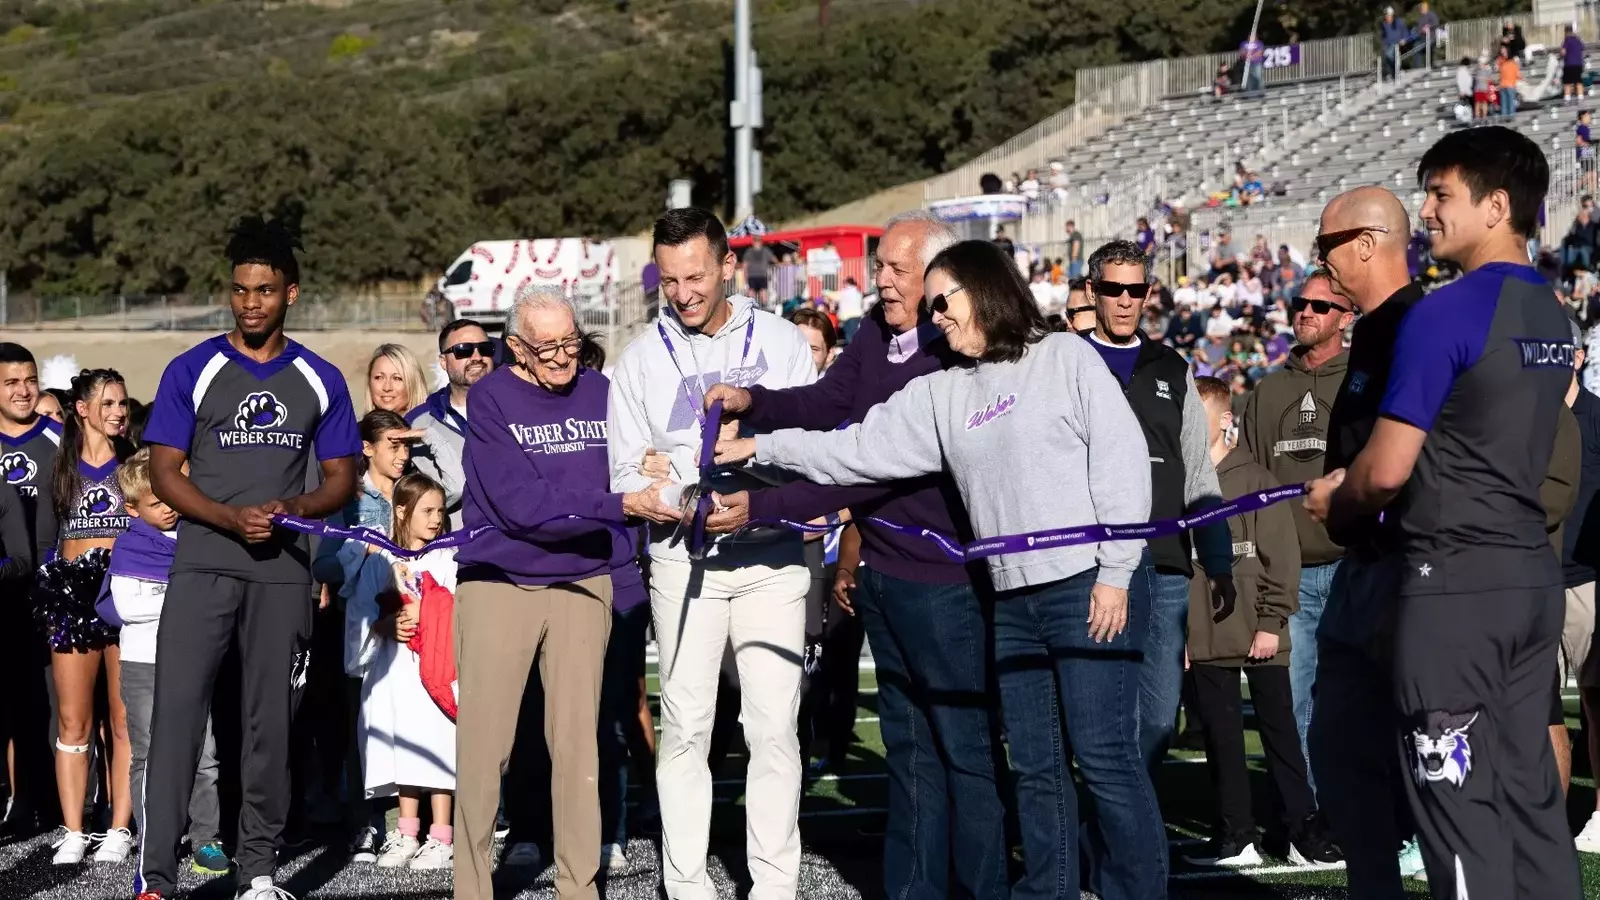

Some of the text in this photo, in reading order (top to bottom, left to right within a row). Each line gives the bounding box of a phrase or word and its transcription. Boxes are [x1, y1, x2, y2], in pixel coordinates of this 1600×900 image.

[1263, 45, 1292, 69] 215
[1521, 342, 1575, 365] WILDCATS
[966, 393, 1017, 431] Weber
[219, 431, 303, 449] WEBER STATE
[543, 441, 586, 455] UNIVERSITY
[1287, 440, 1307, 450] YEARS
[1307, 439, 1326, 450] STRO
[19, 485, 39, 498] STA
[69, 517, 101, 530] WEBER
